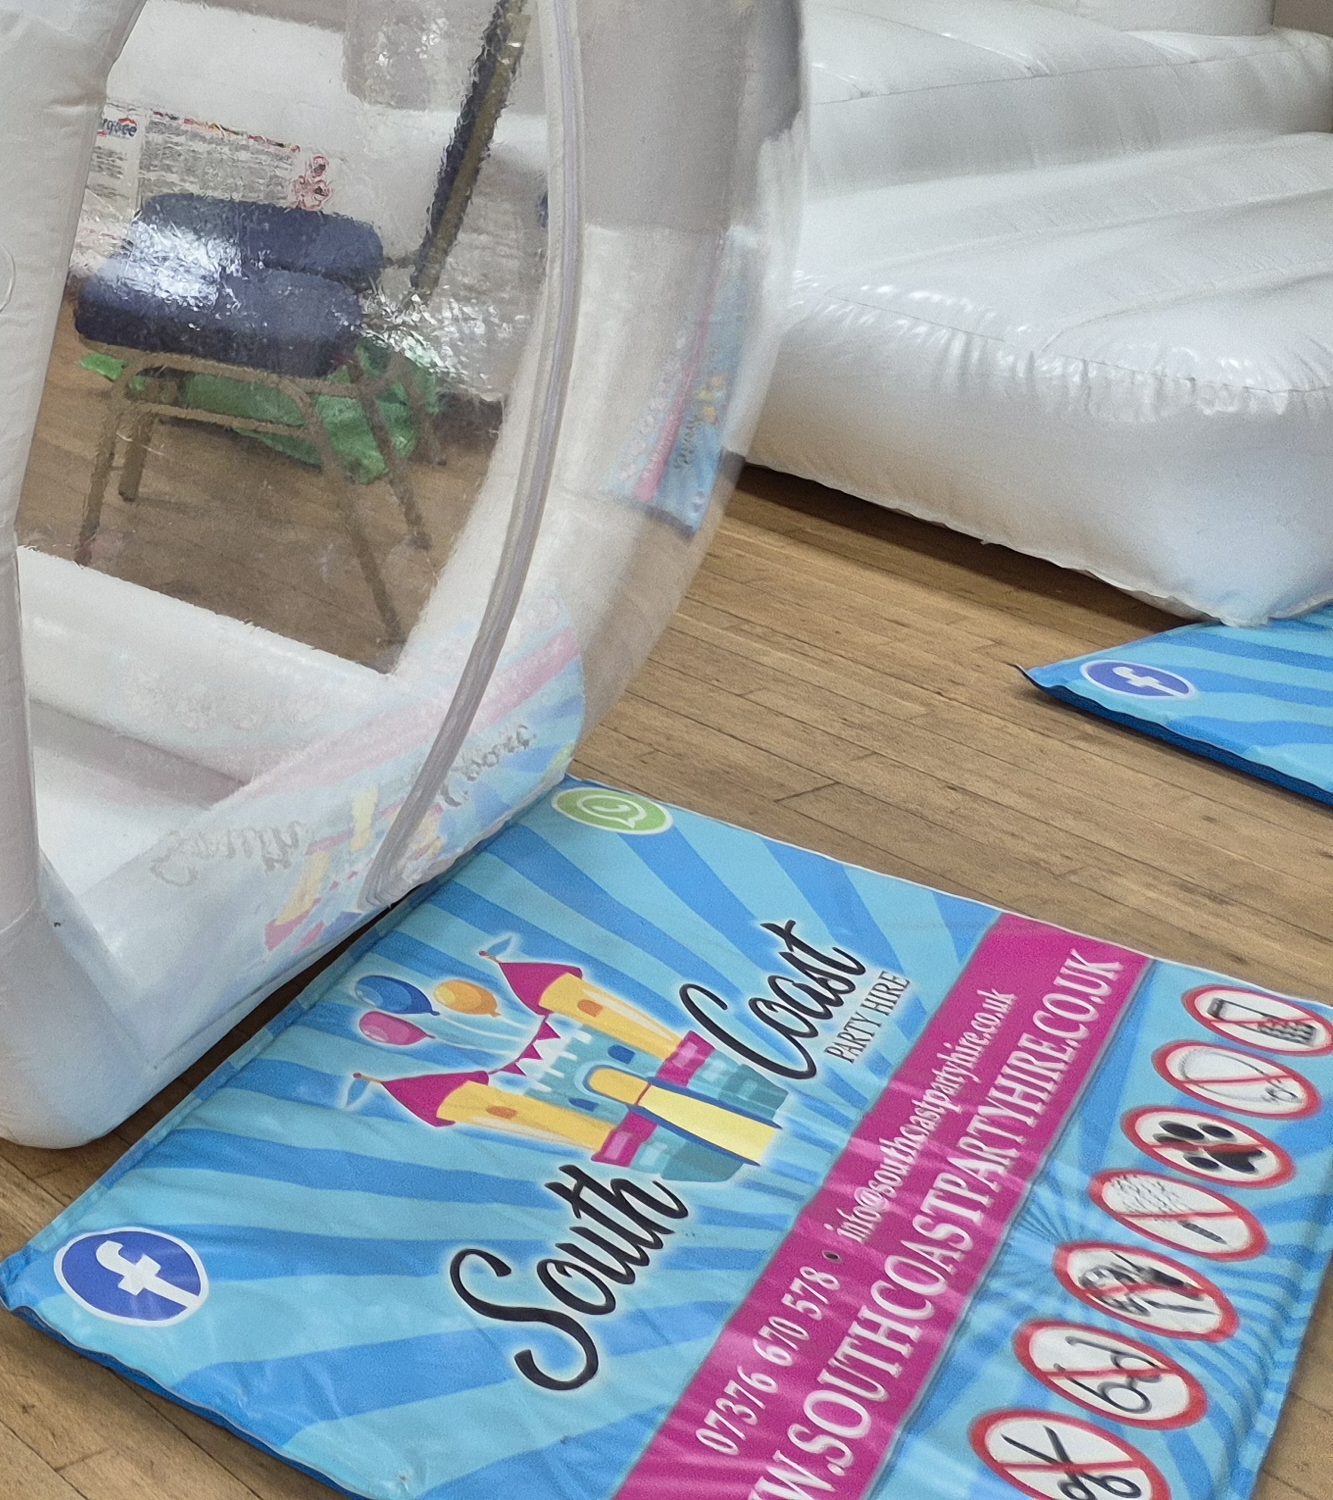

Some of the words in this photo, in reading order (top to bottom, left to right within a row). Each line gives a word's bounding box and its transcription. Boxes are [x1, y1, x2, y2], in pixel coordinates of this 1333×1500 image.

[824, 1011, 882, 1064] PARTY
[861, 970, 911, 1017] HIRE
[450, 1164, 689, 1391] South
[679, 919, 866, 1080] Coast
[781, 1265, 840, 1321] 578
[753, 1316, 810, 1367] 670
[696, 1365, 779, 1456] 07376
